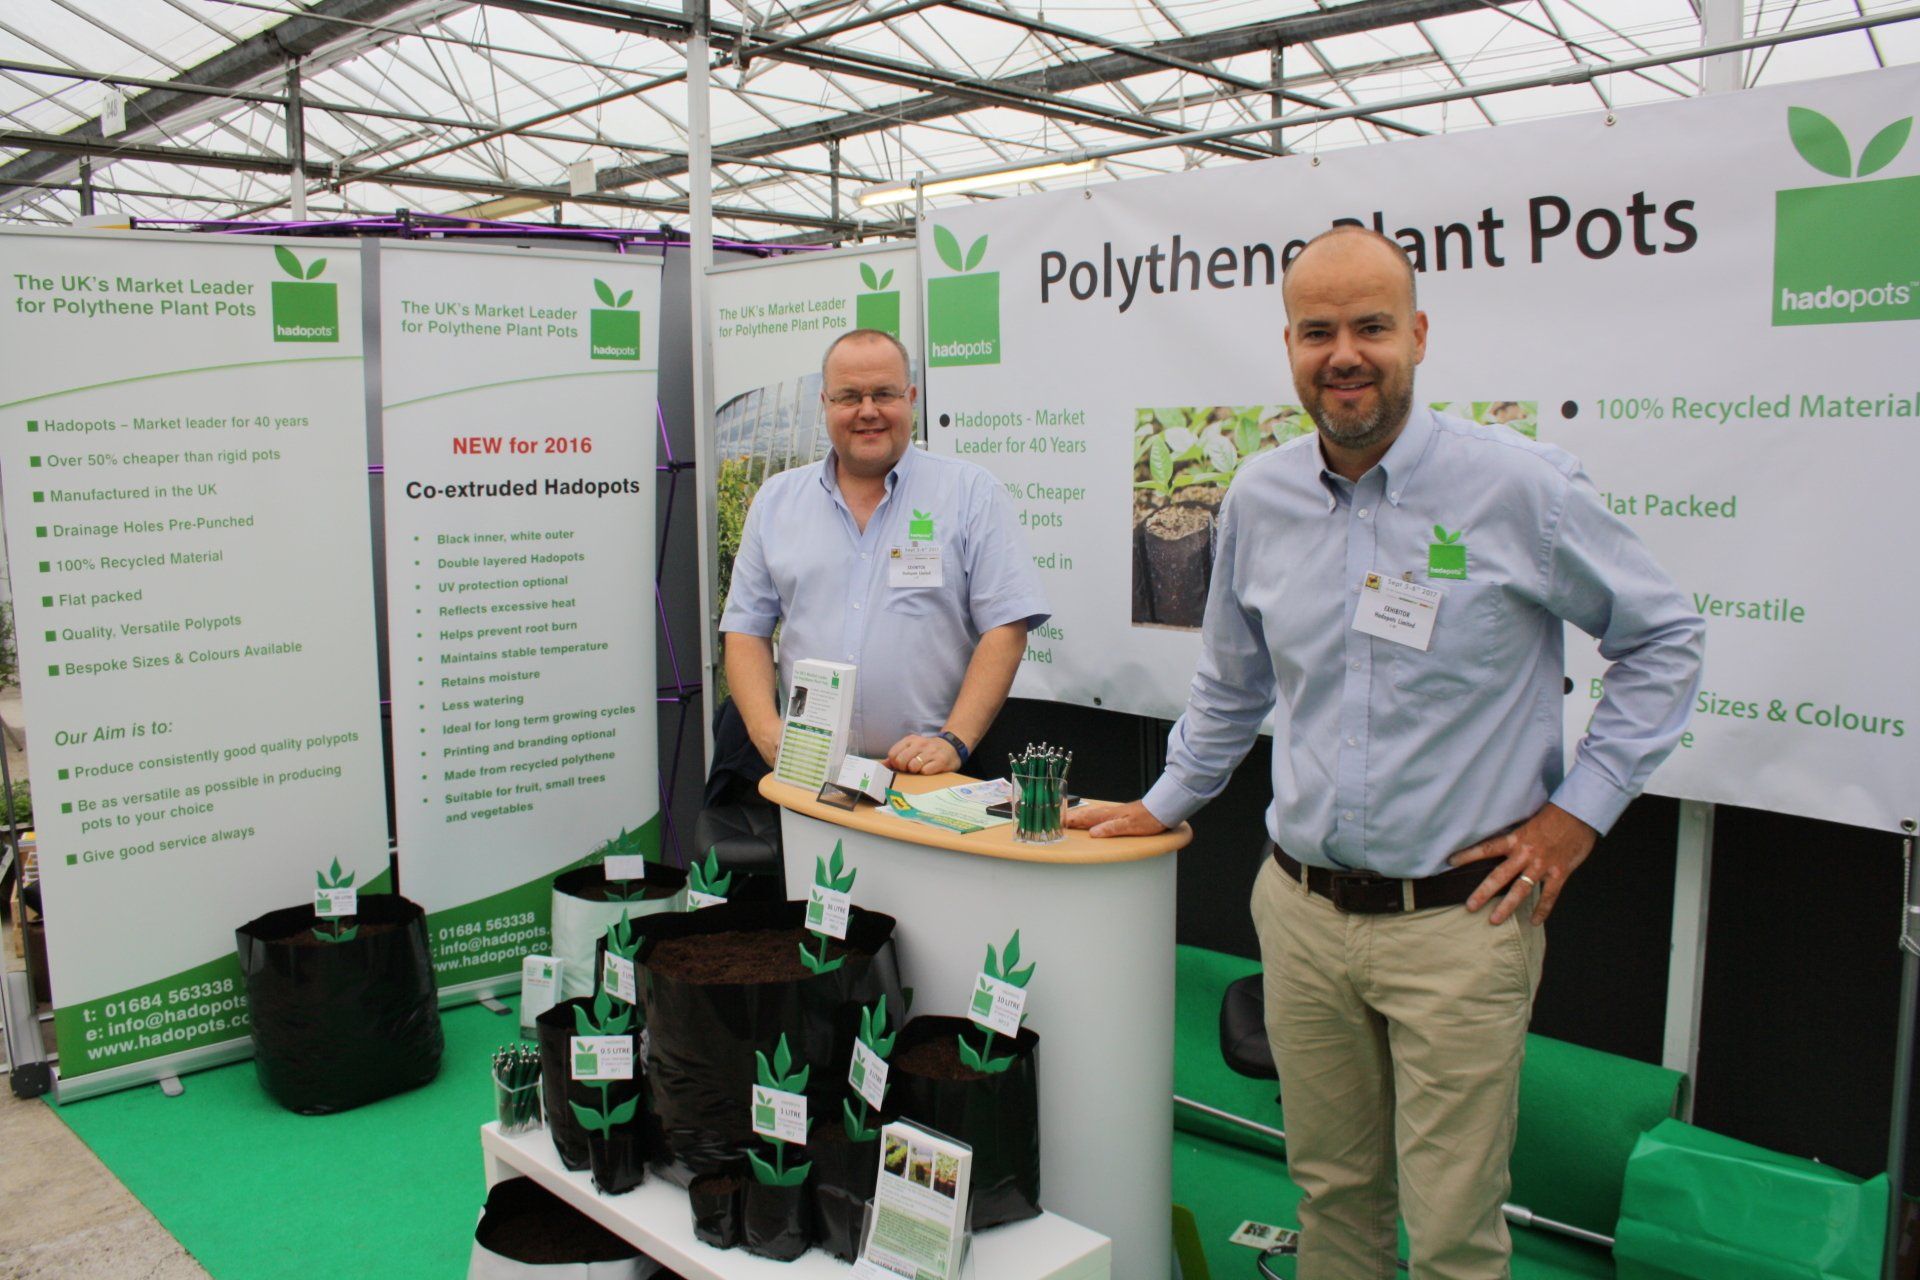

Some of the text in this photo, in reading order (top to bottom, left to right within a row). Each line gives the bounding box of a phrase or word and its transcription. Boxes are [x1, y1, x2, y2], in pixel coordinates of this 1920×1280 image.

[1332, 206, 1506, 274] ant
[1529, 191, 1698, 263] Pots
[14, 274, 254, 294] The UK's Market Leader
[16, 297, 256, 318] for Polythene Plant Pots
[401, 300, 577, 320] The UK's Market Leader
[741, 298, 846, 318] UK's Market Leader
[401, 320, 578, 338] for Polythene Plant Pots
[736, 316, 846, 338] Polythene Plant Pots
[1597, 392, 1920, 424] 100% Recycled Material
[44, 416, 308, 434] Hadopots Market leader for 40 years
[955, 408, 1085, 430] Hadopots Market
[454, 437, 592, 454] NEW for 2016
[956, 436, 1086, 453] Leader for 40 Years
[47, 449, 280, 467] Over 50% cheaper than rigid pots
[50, 484, 216, 502] Manufactured the UK
[406, 478, 640, 499] Co-extruded Hadopots
[1027, 483, 1085, 504] Cheaper
[1600, 492, 1736, 518] lat Packed
[53, 515, 254, 538] Drainage Holes Pre-Punched
[1032, 512, 1062, 530] pots
[437, 534, 470, 544] Black
[510, 531, 542, 540] white
[545, 530, 574, 540] outer
[57, 550, 222, 572] 100% Recycled Material
[438, 553, 585, 568] Double layered Hadopots
[458, 576, 568, 594] protection optional
[59, 589, 142, 607] Flat packed
[439, 598, 576, 616] Reflects excessive heat
[1693, 593, 1805, 623] Versatile
[121, 620, 180, 635] Versatile
[185, 616, 242, 631] Polypots
[440, 622, 577, 641] Helps prevent root burn
[65, 642, 302, 675] Bespoke Sizes Colours Available
[440, 642, 608, 664] Maintains stable temperature
[441, 671, 540, 688] Retains moisture
[442, 695, 524, 711] Less watering
[443, 706, 635, 734] Ideal long term growing cycles
[1696, 691, 1904, 737] Sizes & Colours
[55, 731, 87, 746] Our
[93, 726, 125, 742] Aim
[444, 728, 616, 758] Printing and branding optional
[74, 732, 359, 778] Produce consistently good quality polypots
[444, 752, 615, 781] Made from recycled polythene
[78, 766, 342, 812] Be as versatile as possible producing
[445, 790, 492, 804] Suitable
[546, 777, 575, 790] small
[578, 775, 605, 784] trees
[82, 803, 214, 834] pots to your choice
[446, 804, 533, 822] and vegetables
[83, 827, 255, 863] Give good service always
[439, 912, 534, 940] 01684 563338
[105, 979, 232, 1018] 01684 563338
